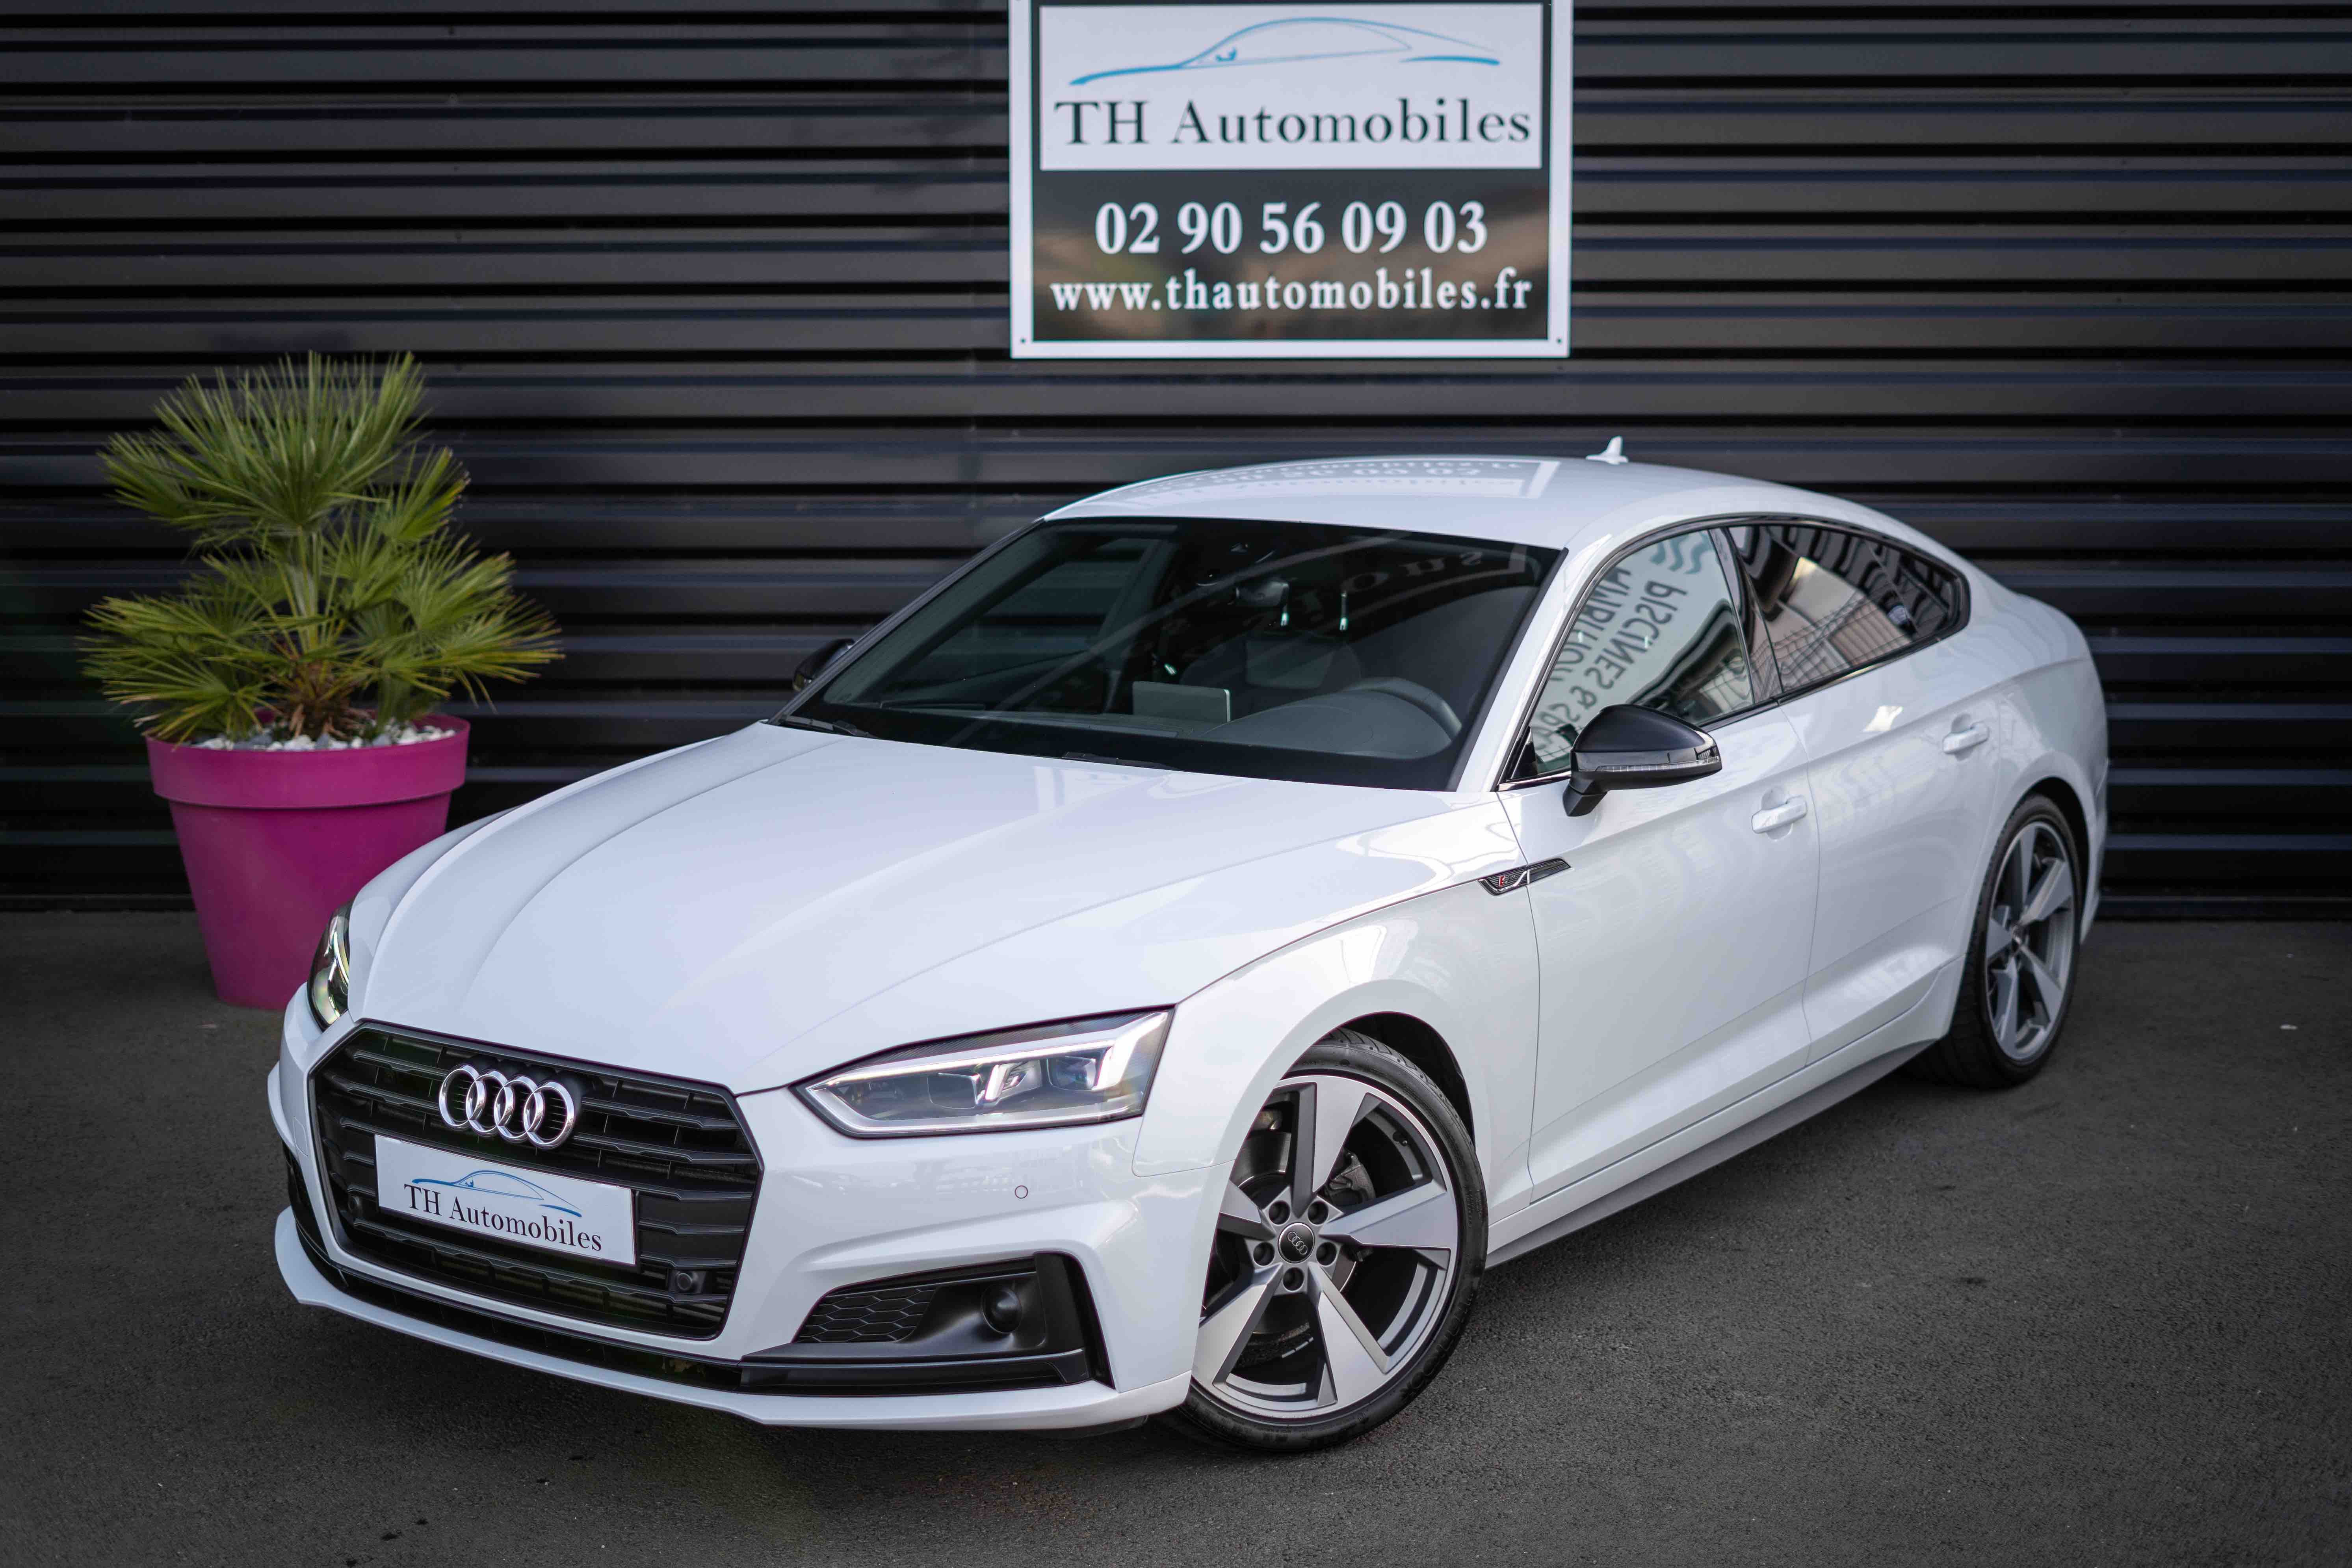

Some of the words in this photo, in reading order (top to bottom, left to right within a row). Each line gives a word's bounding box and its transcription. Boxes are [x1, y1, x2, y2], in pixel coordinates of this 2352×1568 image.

[1054, 100, 1146, 144] TH
[1172, 97, 1530, 143] Automobiles
[1095, 203, 1159, 255] 02
[1178, 202, 1242, 254] 90
[1260, 202, 1324, 254] 56
[1341, 201, 1406, 253] 09
[1424, 201, 1488, 254] 03
[1050, 266, 1531, 310] www.thautomobiles.fr
[404, 1183, 440, 1216] TH
[449, 1196, 602, 1252] Automobiles
